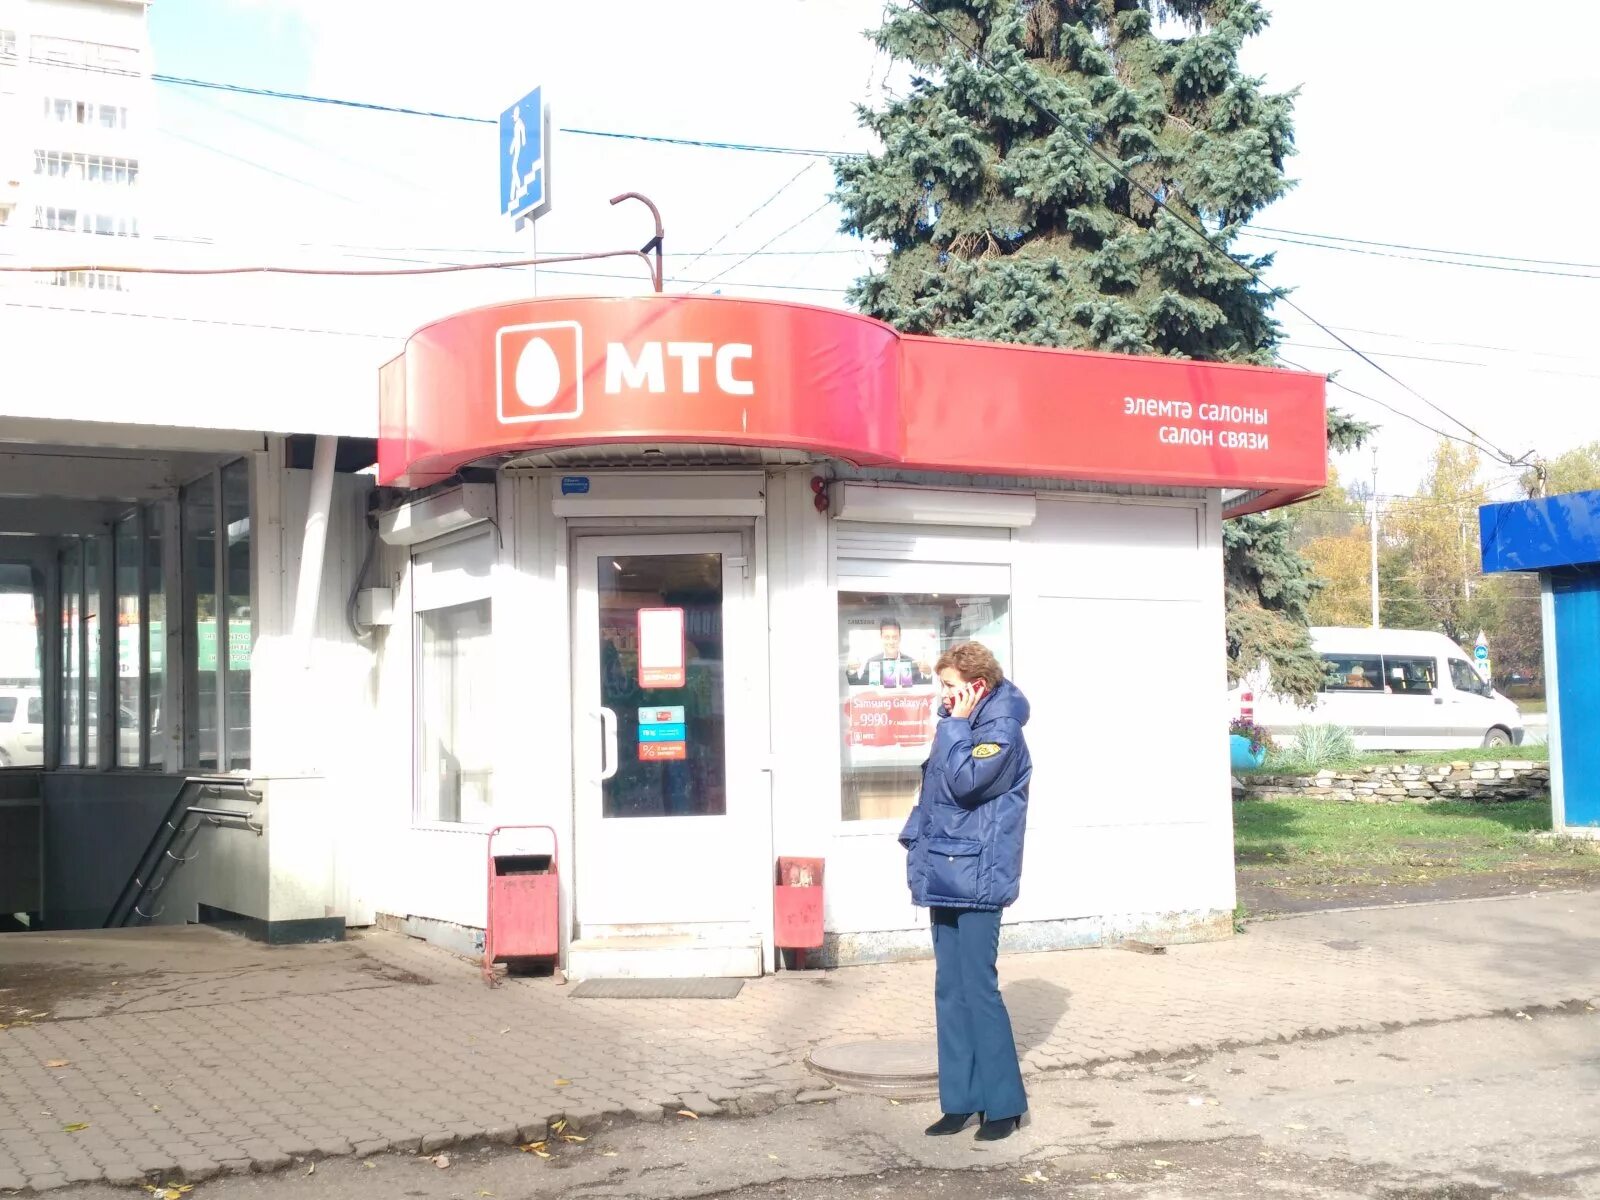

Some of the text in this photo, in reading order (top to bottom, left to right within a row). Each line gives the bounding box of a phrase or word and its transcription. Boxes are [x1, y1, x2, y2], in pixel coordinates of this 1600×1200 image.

[604, 341, 754, 395] МТС
[1123, 397, 1268, 425] элемтә салоны
[1159, 426, 1269, 450] салон связи
[853, 698, 891, 710] Samsung
[893, 698, 919, 709] Galaxy
